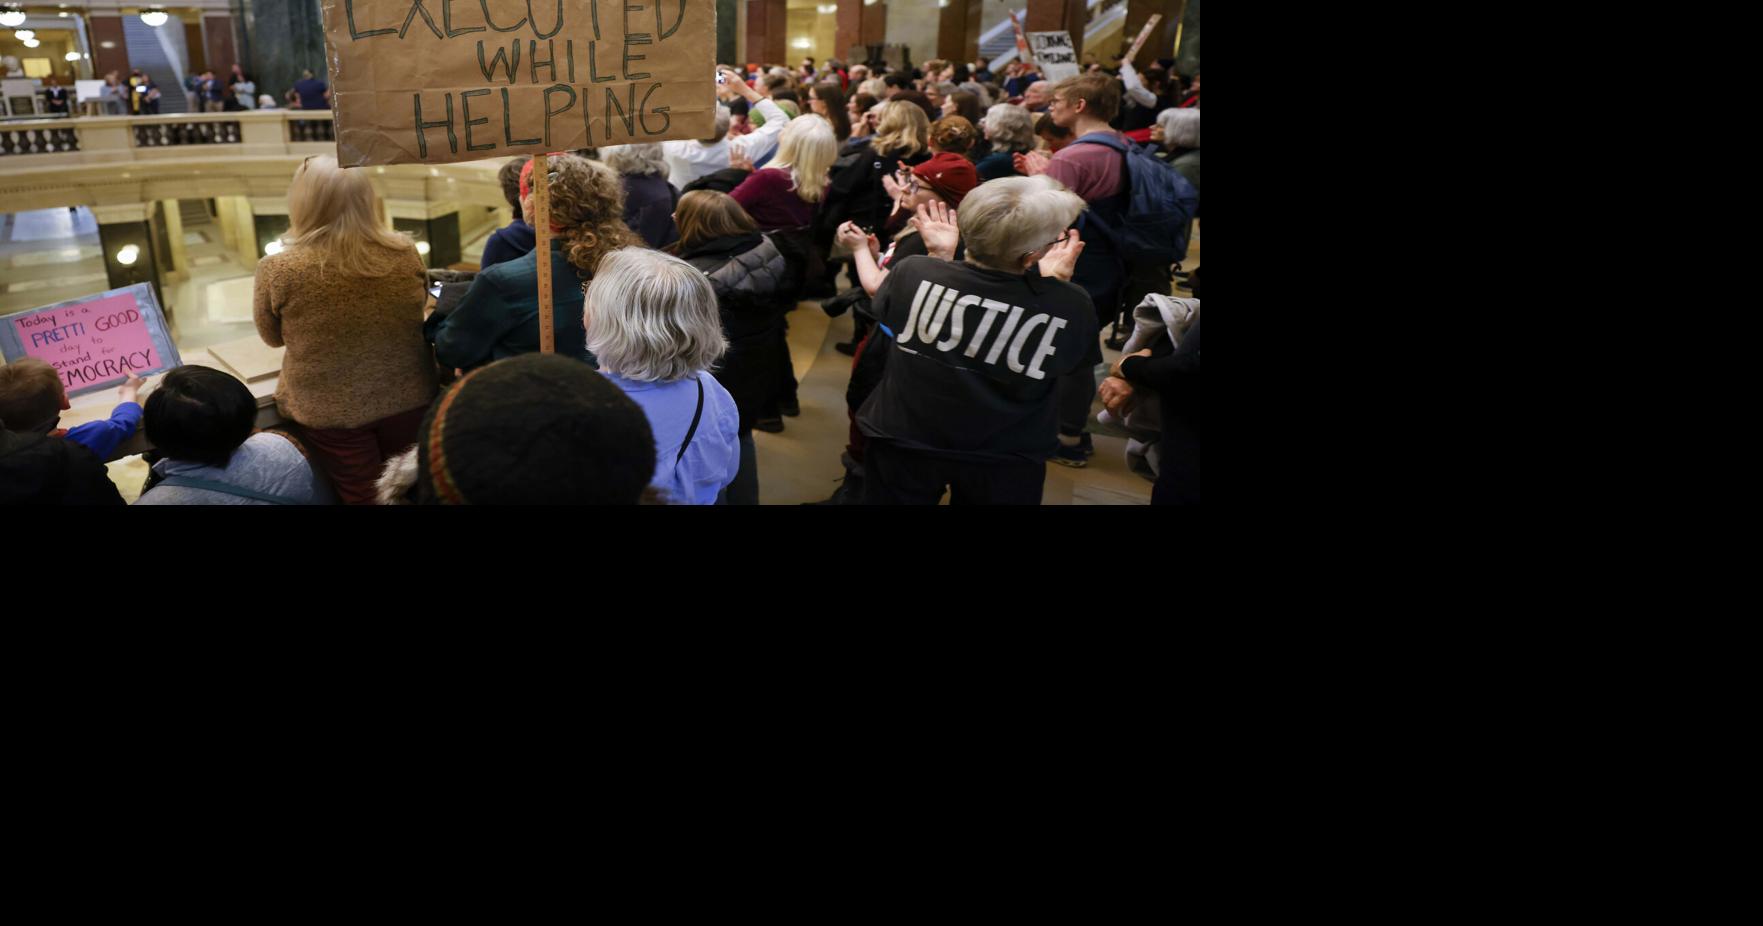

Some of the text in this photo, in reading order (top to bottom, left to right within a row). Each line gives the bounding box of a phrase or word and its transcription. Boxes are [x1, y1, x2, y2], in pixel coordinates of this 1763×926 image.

[477, 39, 652, 84] WHILE
[414, 83, 670, 158] HELPING
[15, 314, 57, 328] Today
[31, 309, 139, 348] PRETTI GOOD
[896, 280, 1068, 380] JUSTICE
[58, 348, 152, 388] MOCRACY
